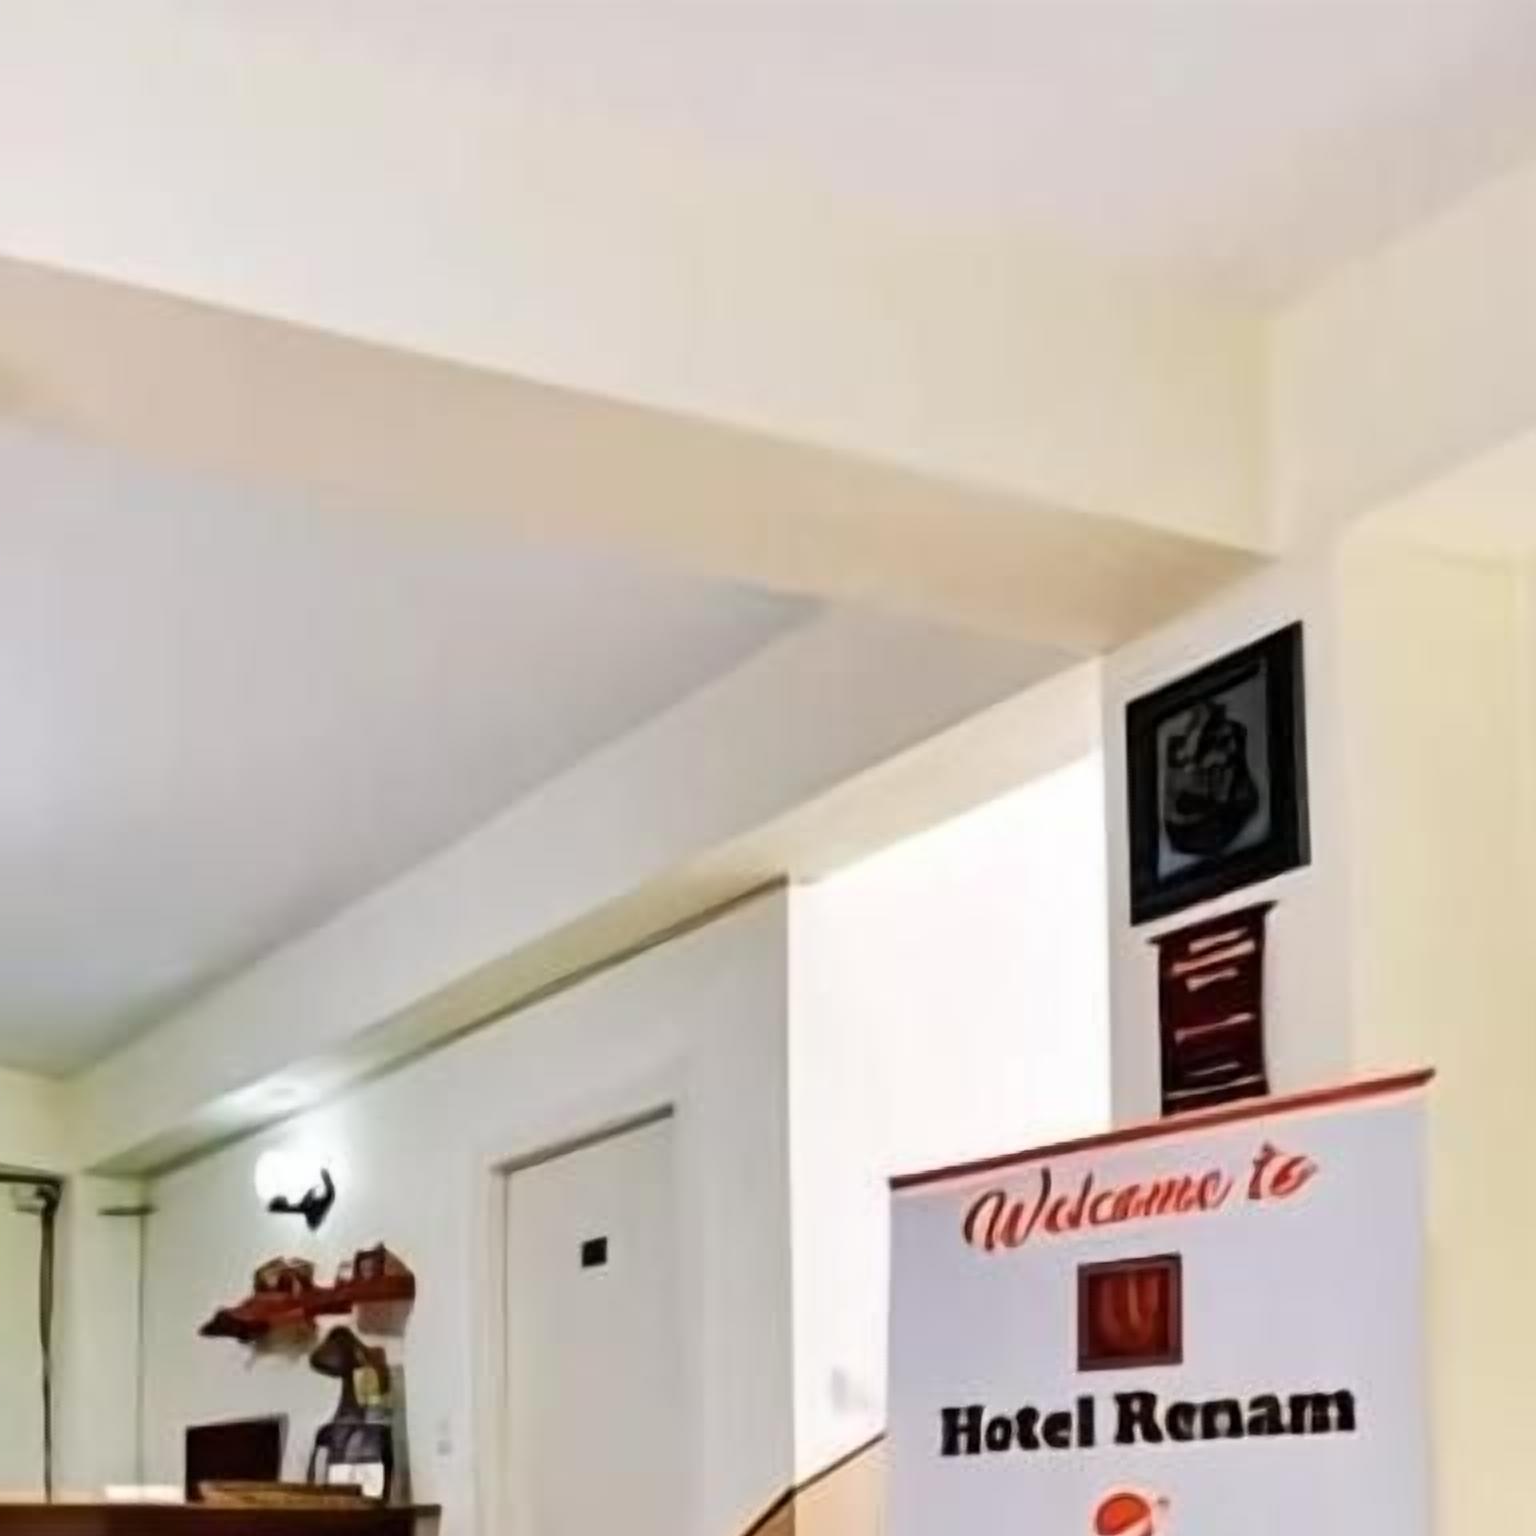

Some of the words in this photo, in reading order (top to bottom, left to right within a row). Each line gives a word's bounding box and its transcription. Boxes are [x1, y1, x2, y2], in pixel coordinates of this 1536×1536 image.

[962, 1167, 1233, 1252] Welcome
[1249, 1145, 1319, 1200] to
[940, 1395, 1095, 1456] Hotel
[1114, 1389, 1356, 1445] Renam
